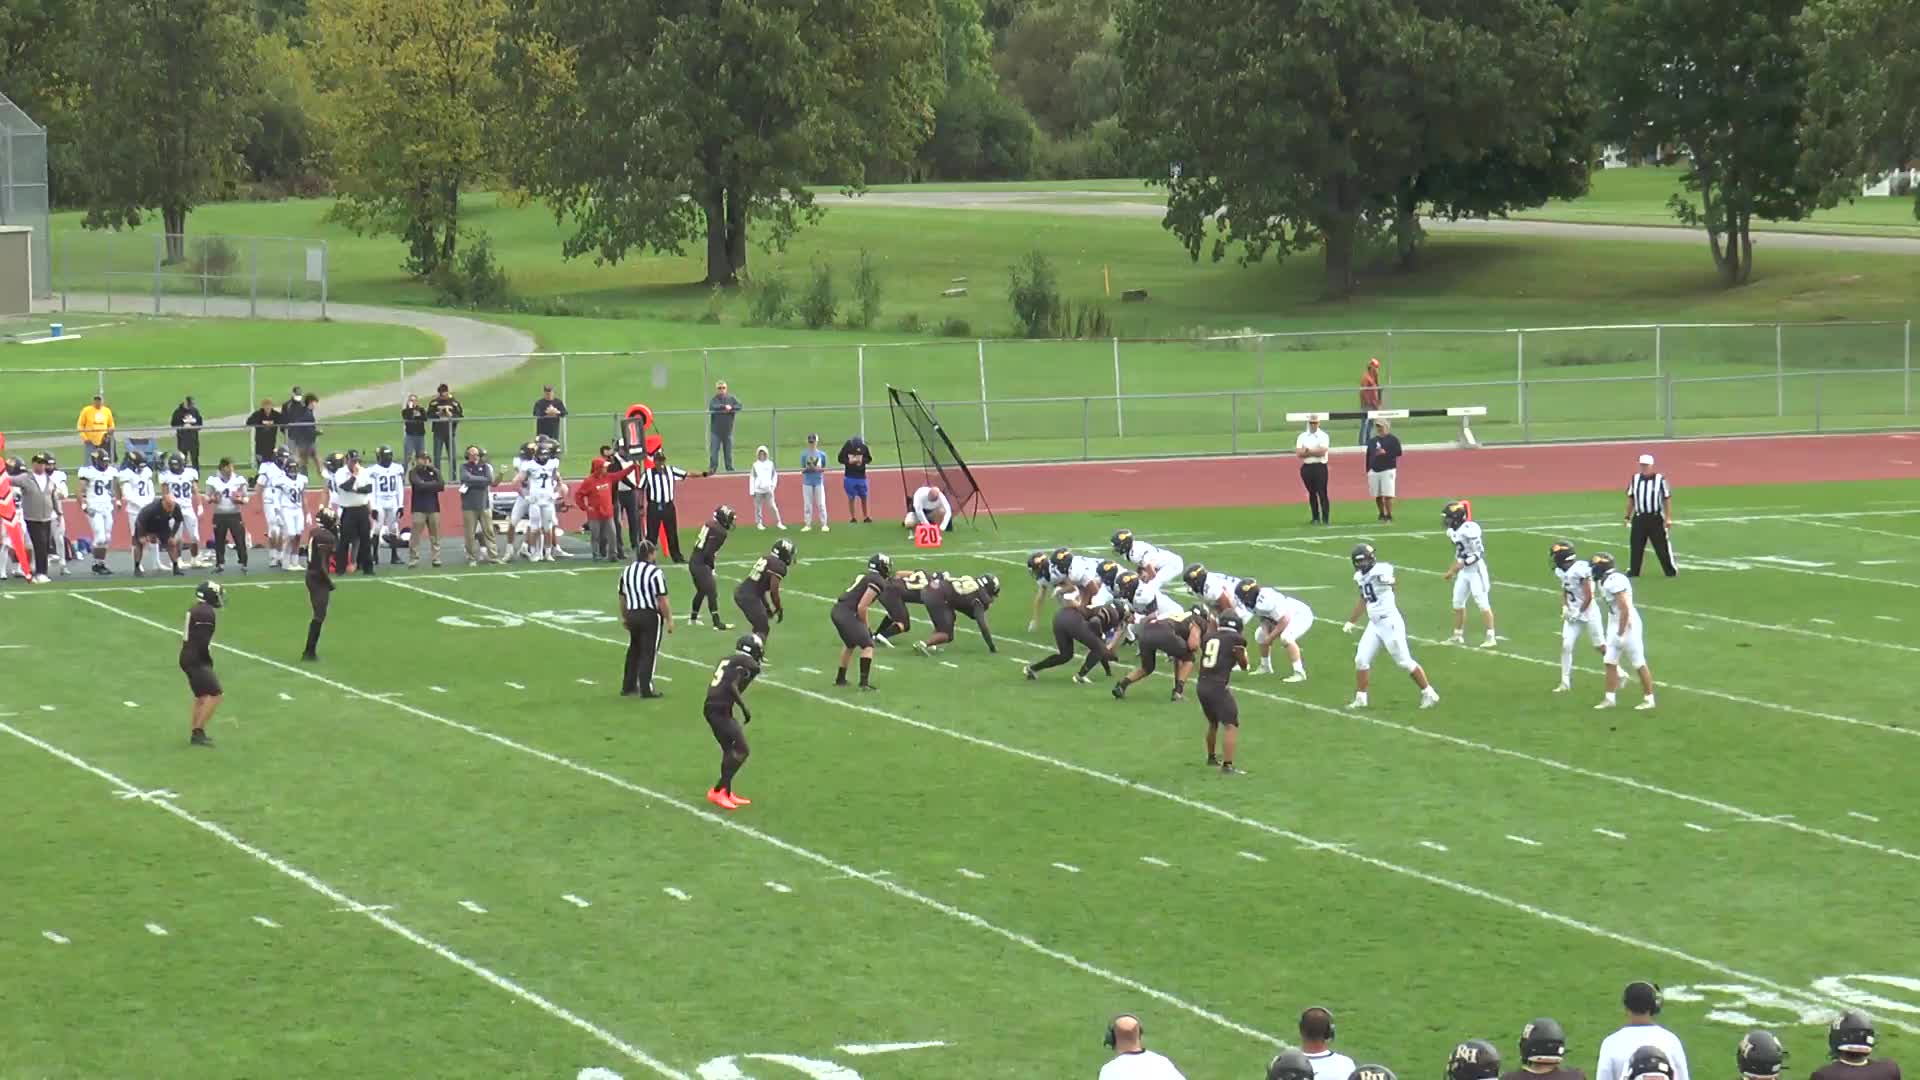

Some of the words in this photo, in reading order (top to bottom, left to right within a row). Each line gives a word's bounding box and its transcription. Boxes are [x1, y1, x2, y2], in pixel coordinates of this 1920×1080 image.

[379, 475, 397, 493] 20
[920, 527, 938, 545] 20
[1203, 638, 1220, 668] 9
[711, 660, 730, 687] 5
